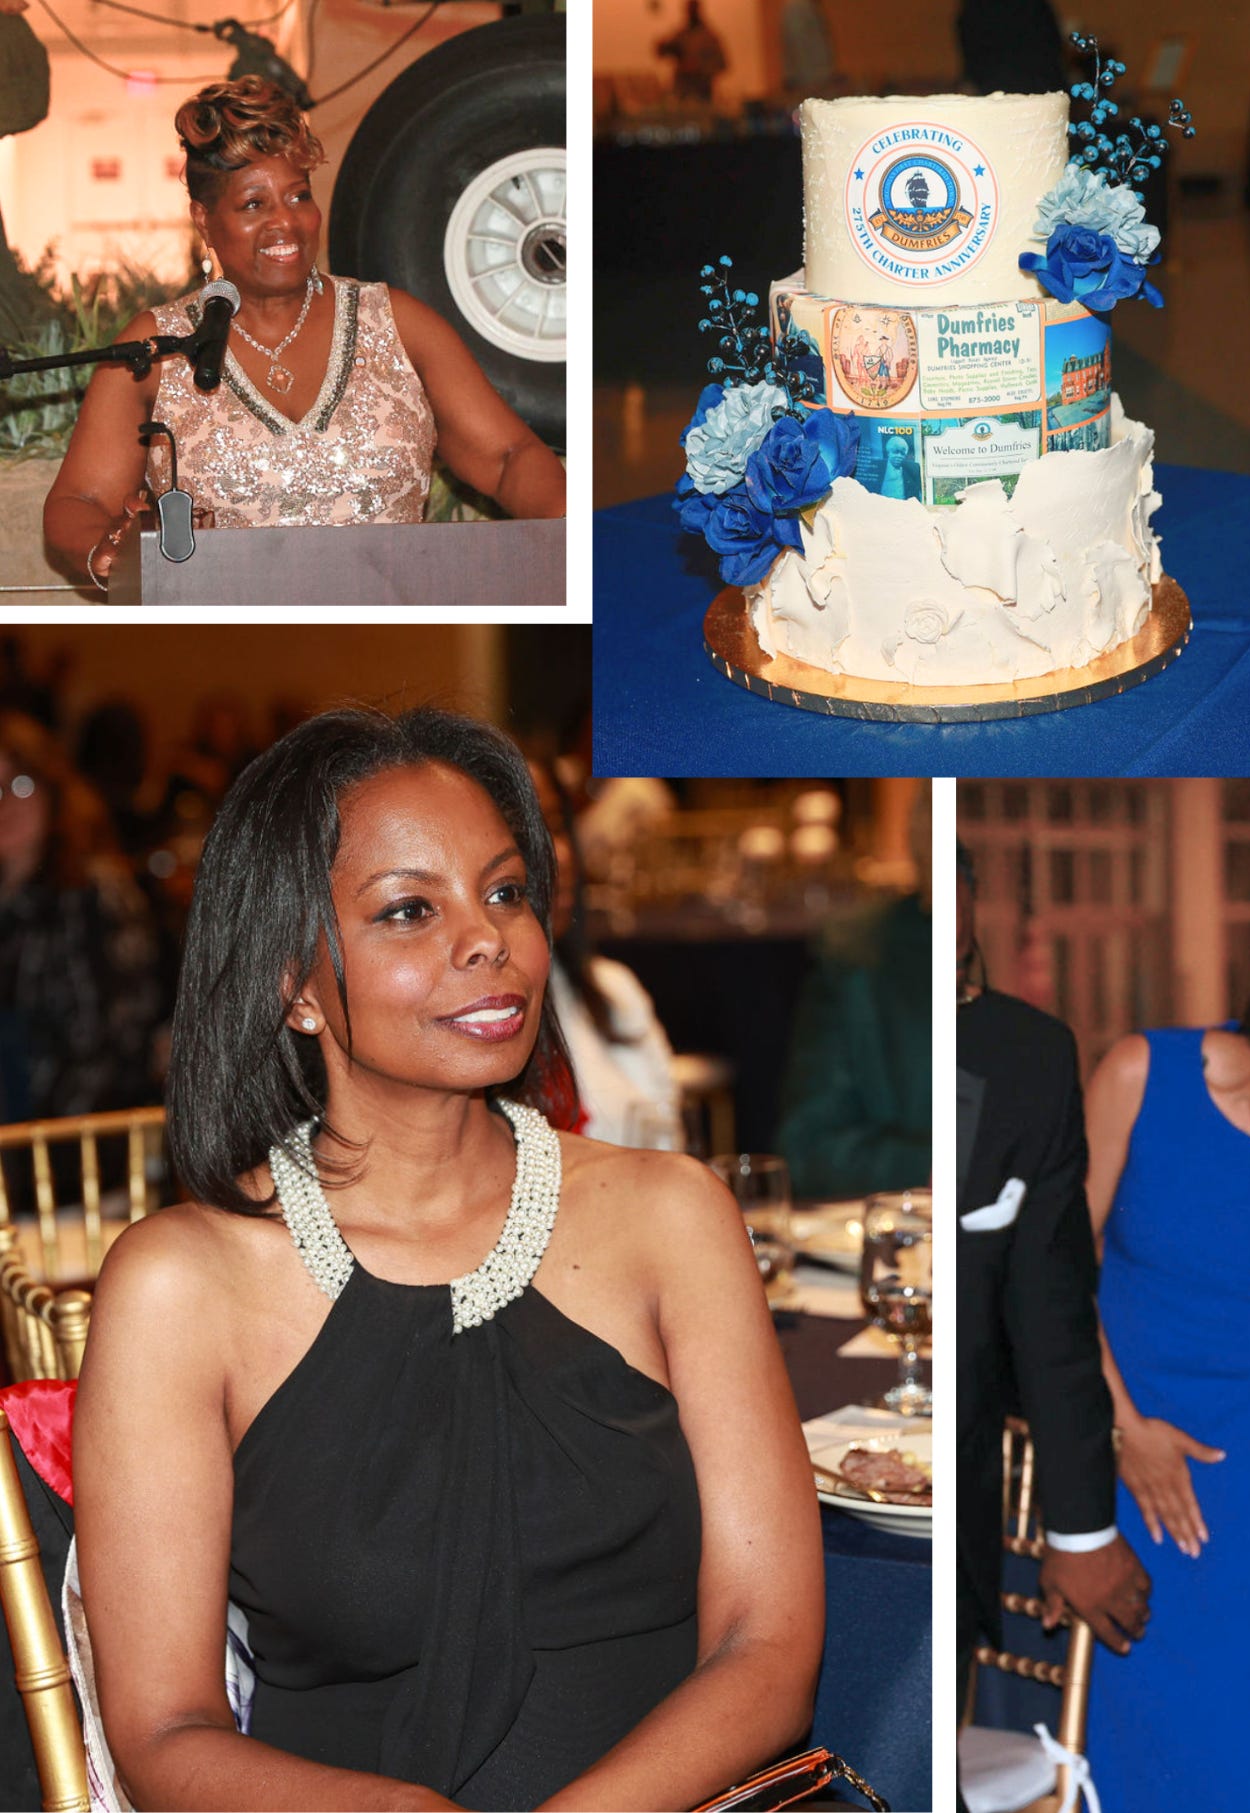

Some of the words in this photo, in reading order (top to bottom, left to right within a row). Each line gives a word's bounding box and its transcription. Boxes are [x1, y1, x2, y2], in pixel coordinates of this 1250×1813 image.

[872, 129, 963, 154] CELEBRATING
[852, 207, 874, 250] 275TH
[872, 249, 929, 279] CHARTER
[934, 203, 991, 277] ANNIVERSARY
[891, 232, 951, 249] DUMFRIES
[937, 311, 1015, 335] Dumfries
[937, 336, 1020, 358] Pharmacy
[990, 360, 1012, 368] CENTER
[968, 395, 1001, 404] 875-2000
[933, 445, 976, 455] Welcome
[977, 445, 987, 454] to
[990, 440, 1032, 453] Dumfries
